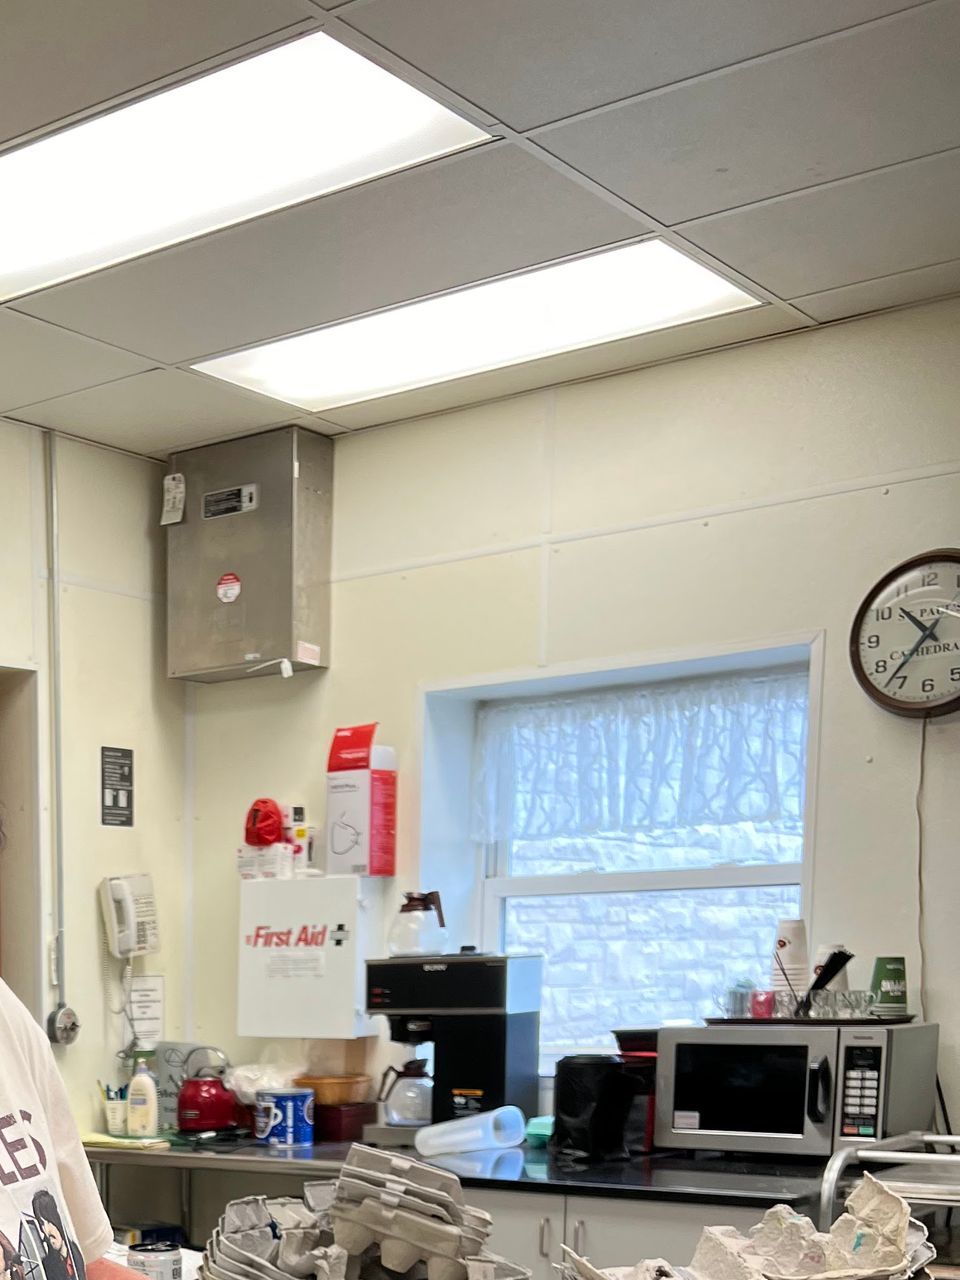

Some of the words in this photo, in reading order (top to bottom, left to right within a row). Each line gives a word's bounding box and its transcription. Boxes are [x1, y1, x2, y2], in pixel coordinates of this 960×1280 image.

[921, 572, 939, 588] 12
[875, 606, 892, 622] 10
[867, 634, 880, 649] 9
[890, 642, 960, 661] CAHEDRA
[874, 659, 887, 674] 8
[895, 675, 908, 690] 7
[921, 678, 935, 693] 6
[252, 925, 292, 948] First
[294, 924, 328, 947] Aid
